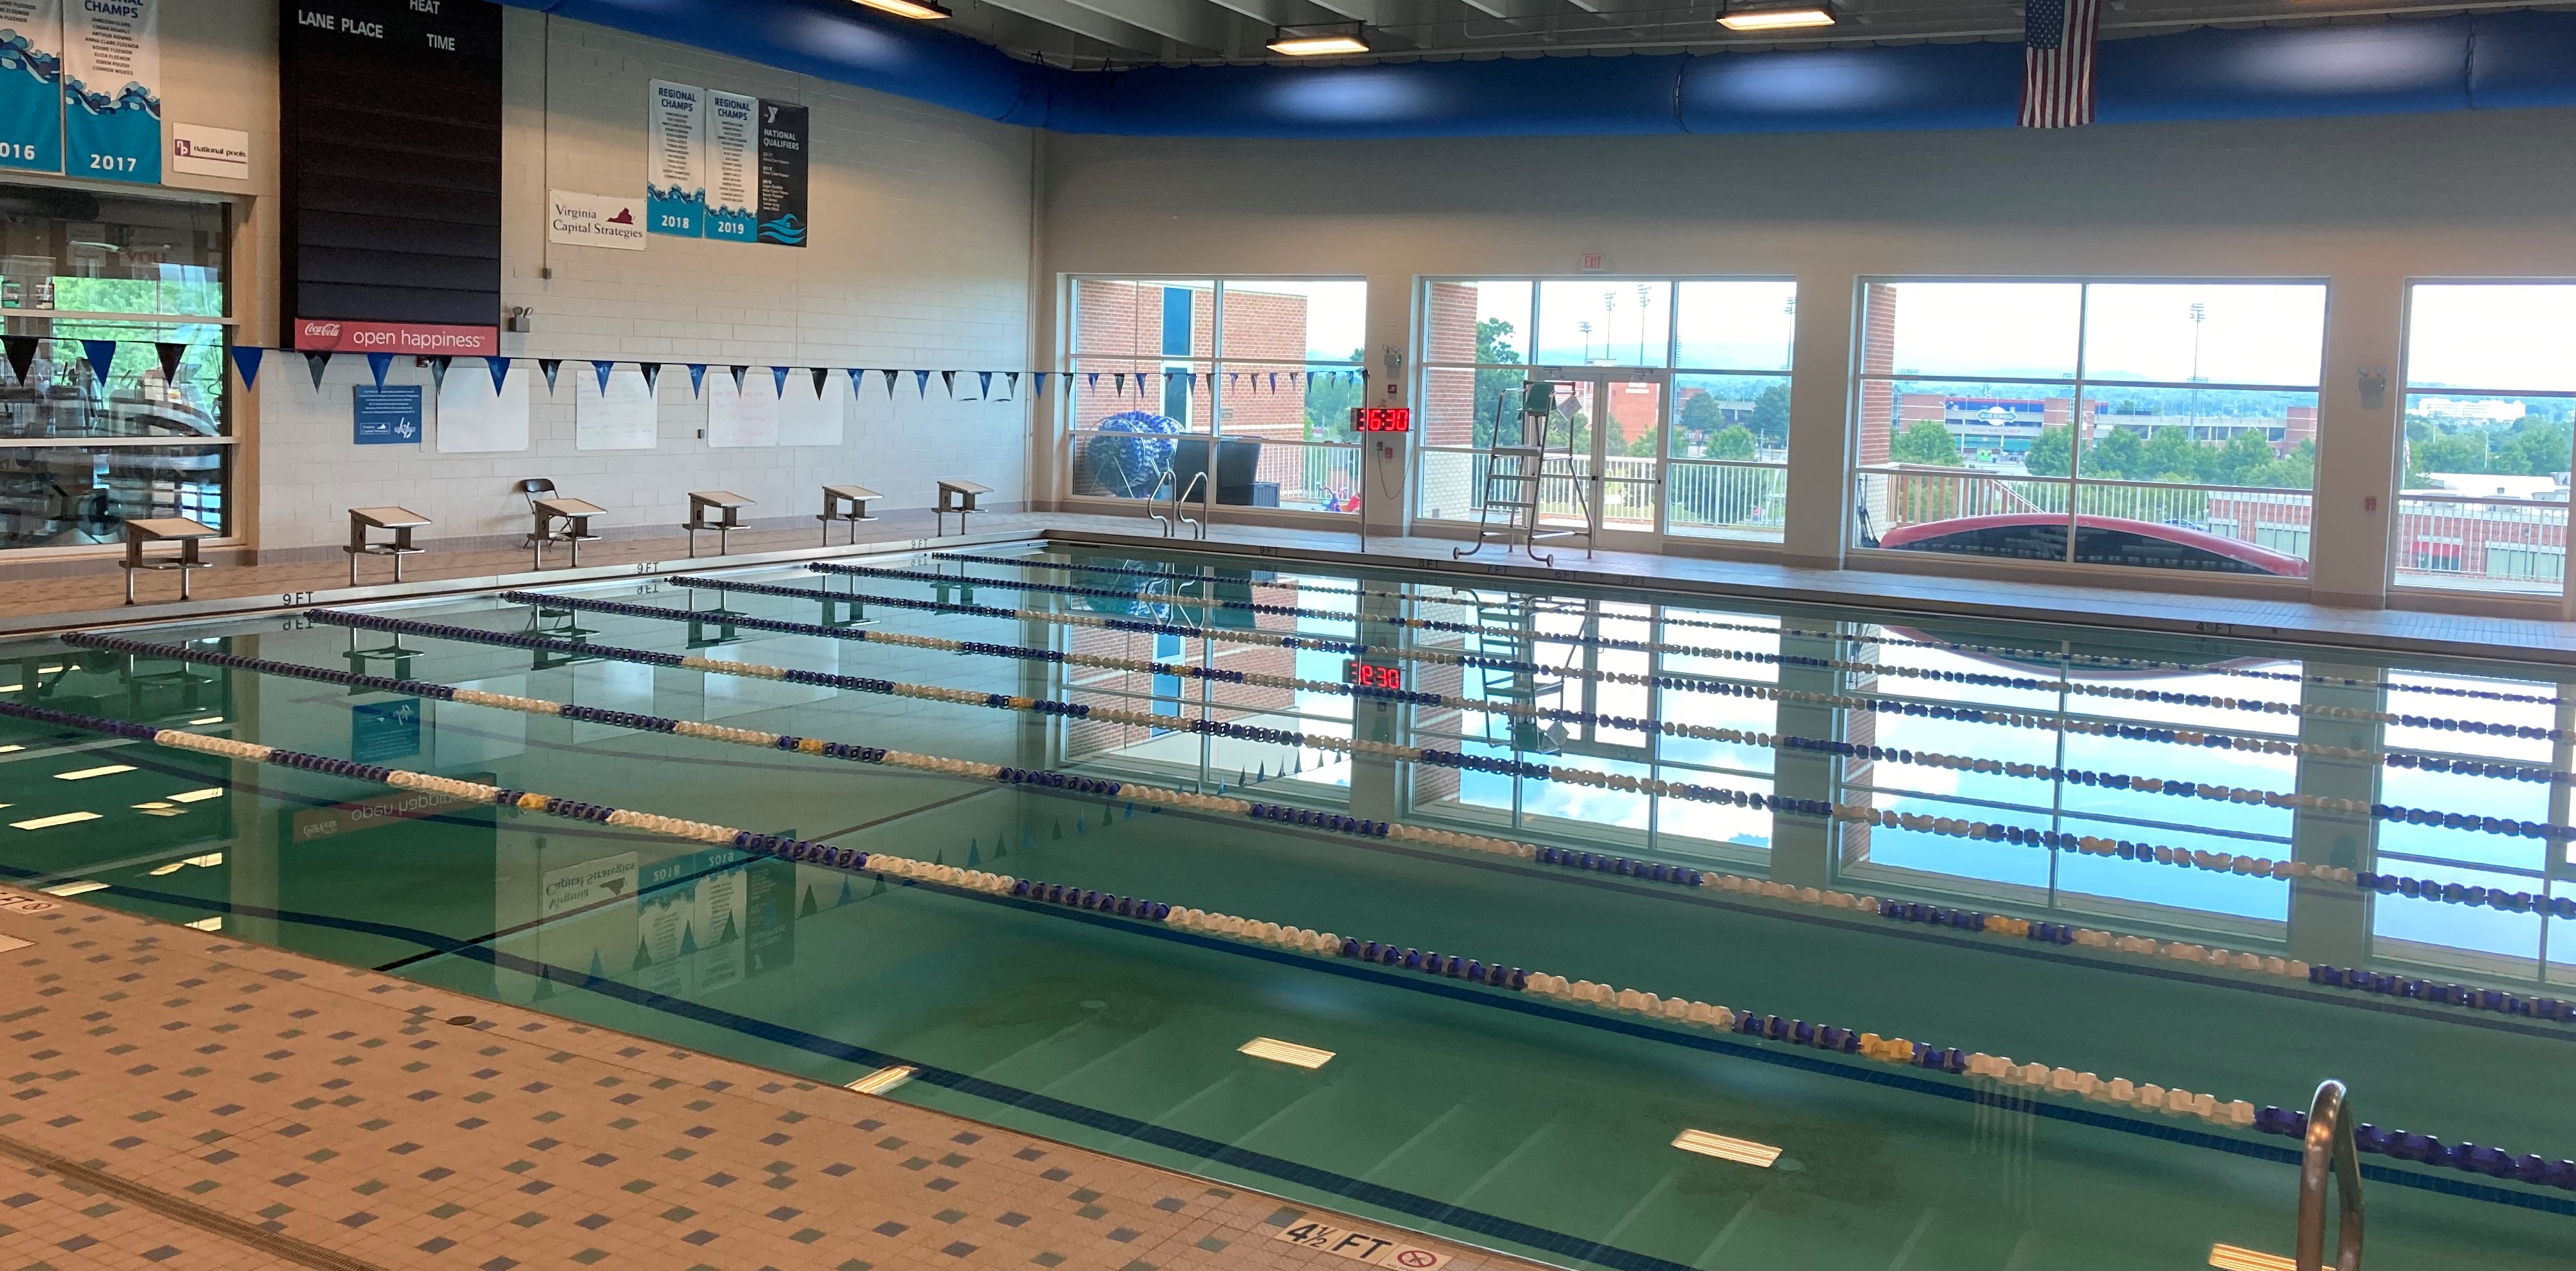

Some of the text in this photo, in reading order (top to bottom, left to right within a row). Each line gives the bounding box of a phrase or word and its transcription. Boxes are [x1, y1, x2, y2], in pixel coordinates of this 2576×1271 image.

[85, 0, 138, 18] CHAMPS
[409, 0, 440, 14] HEAT
[298, 10, 383, 39] LANE PLACE
[427, 34, 455, 51] TIME
[658, 87, 696, 102] REGIONAL
[661, 99, 693, 112] CHAMPS
[715, 98, 751, 111] REGIONAL
[718, 108, 747, 121] CHAMPS
[764, 129, 796, 141] NATIONAL
[194, 146, 223, 154] national
[763, 138, 799, 150] QUALIFIERS
[90, 154, 136, 172] 2017
[555, 203, 597, 219] Virginia
[661, 215, 689, 229] 2018
[718, 221, 744, 234] 2019
[553, 220, 643, 239] Capital Strategies
[353, 331, 396, 347] open
[637, 563, 659, 574] 9 FT
[283, 592, 314, 605] 9 FT
[1332, 1233, 1394, 1259] FT
